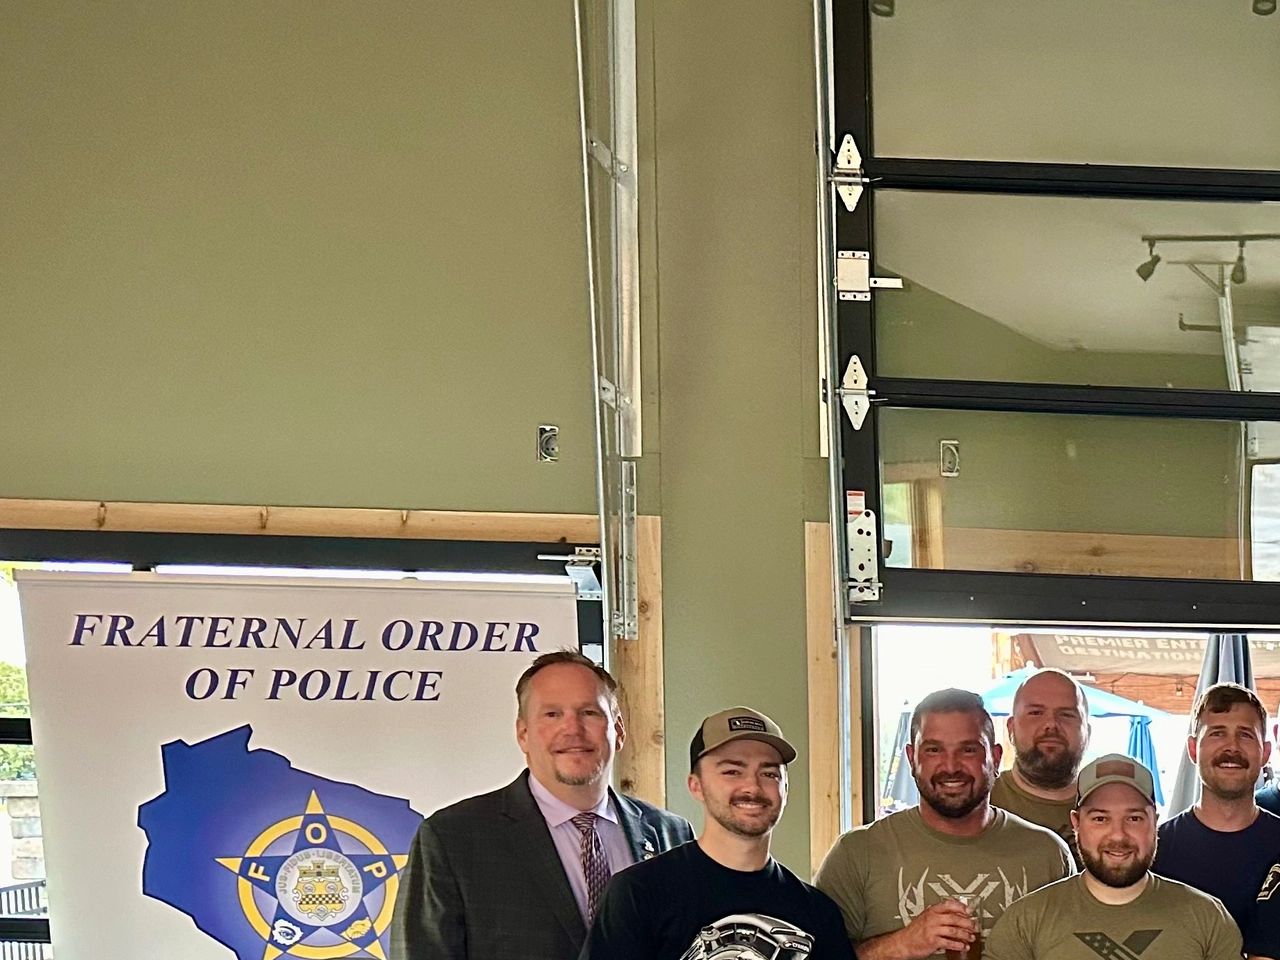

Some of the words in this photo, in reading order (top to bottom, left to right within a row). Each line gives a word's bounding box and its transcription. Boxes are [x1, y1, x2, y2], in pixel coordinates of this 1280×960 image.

[68, 614, 366, 650] FRATERNAL
[381, 619, 541, 653] ORDER
[185, 668, 255, 701] OF
[265, 669, 443, 701] POLICE
